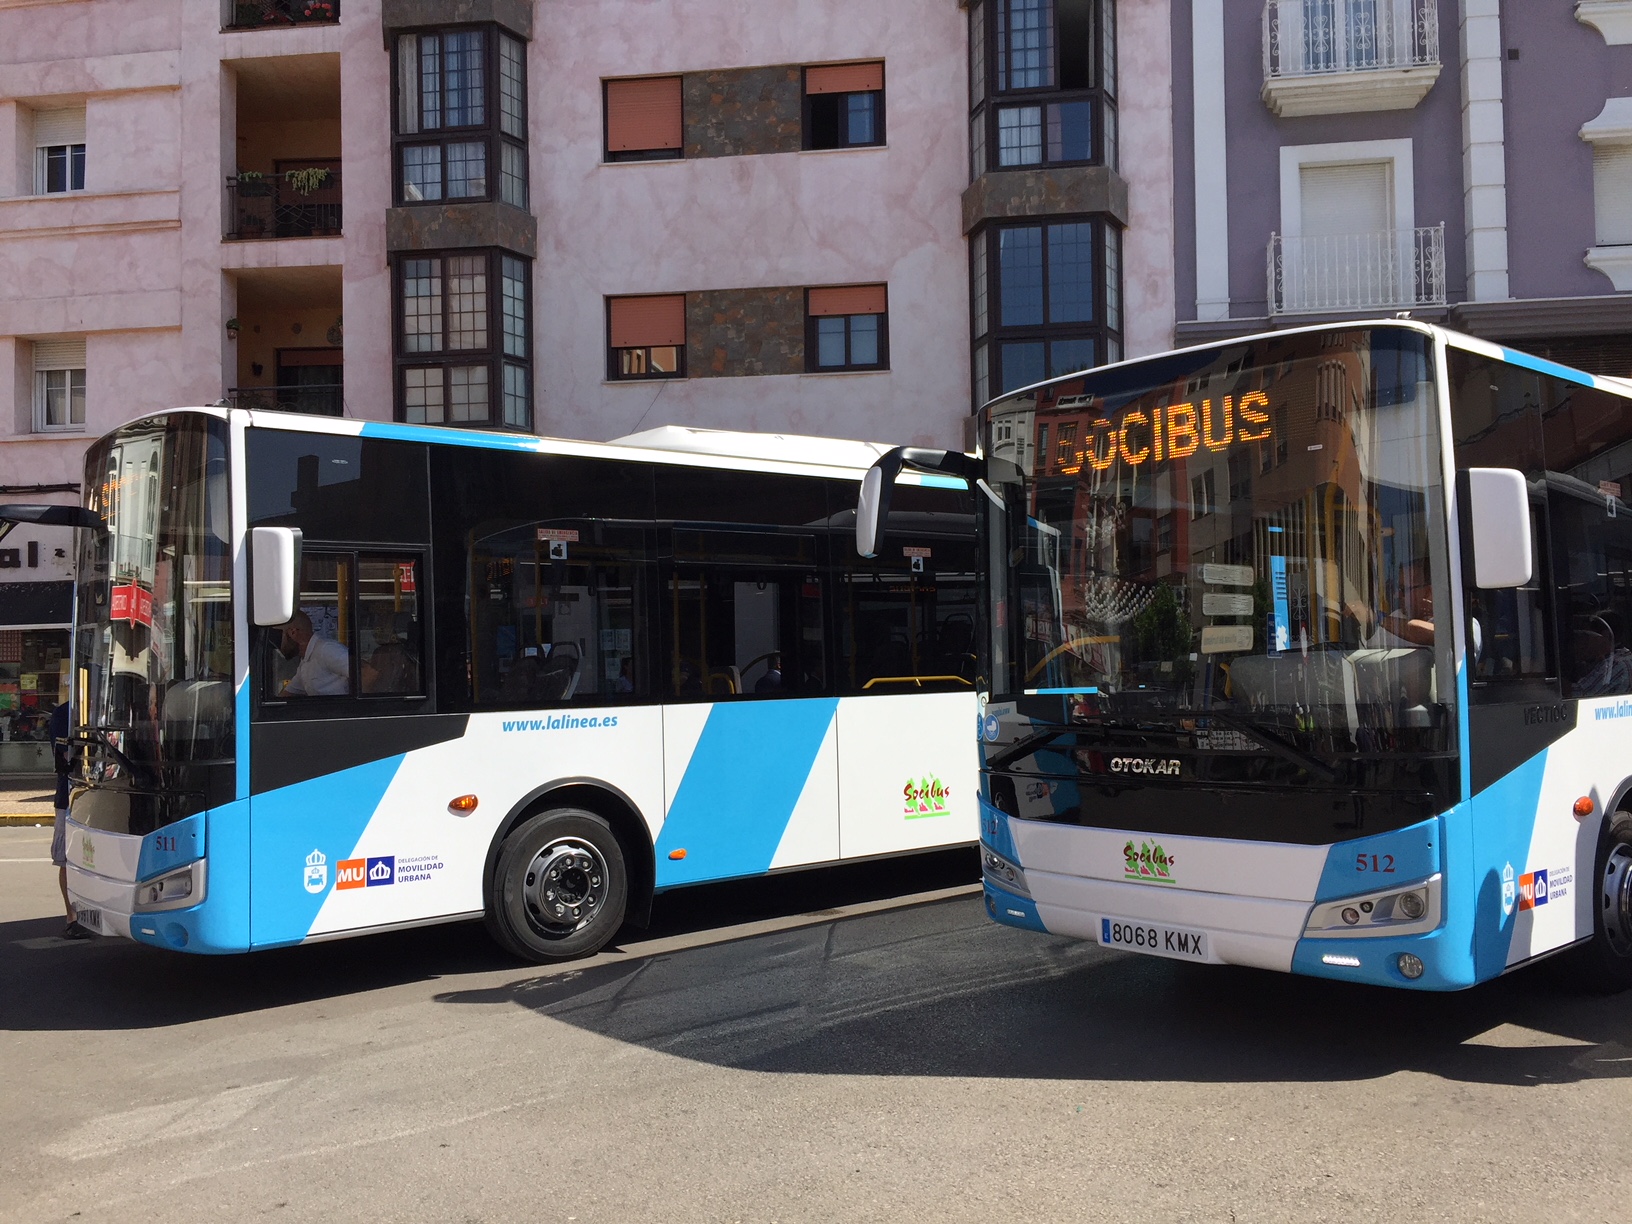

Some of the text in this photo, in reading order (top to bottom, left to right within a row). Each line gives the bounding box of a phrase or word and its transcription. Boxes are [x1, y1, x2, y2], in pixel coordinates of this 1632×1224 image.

[502, 714, 618, 732] www.lalinea.es
[1110, 757, 1182, 775] OTOKAR
[903, 780, 950, 802] Socibus
[156, 836, 177, 851] 511
[1123, 845, 1175, 867] Socibus
[1356, 853, 1396, 873] 512
[337, 867, 365, 883] MU
[398, 862, 444, 874] MOVILIDAD
[398, 873, 432, 883] URBANA
[1549, 874, 1573, 888] MOVILIDAD
[1520, 883, 1533, 901] MU
[1549, 888, 1567, 900] URBANA
[1112, 923, 1158, 948] 8068
[1165, 930, 1202, 956] KMX
